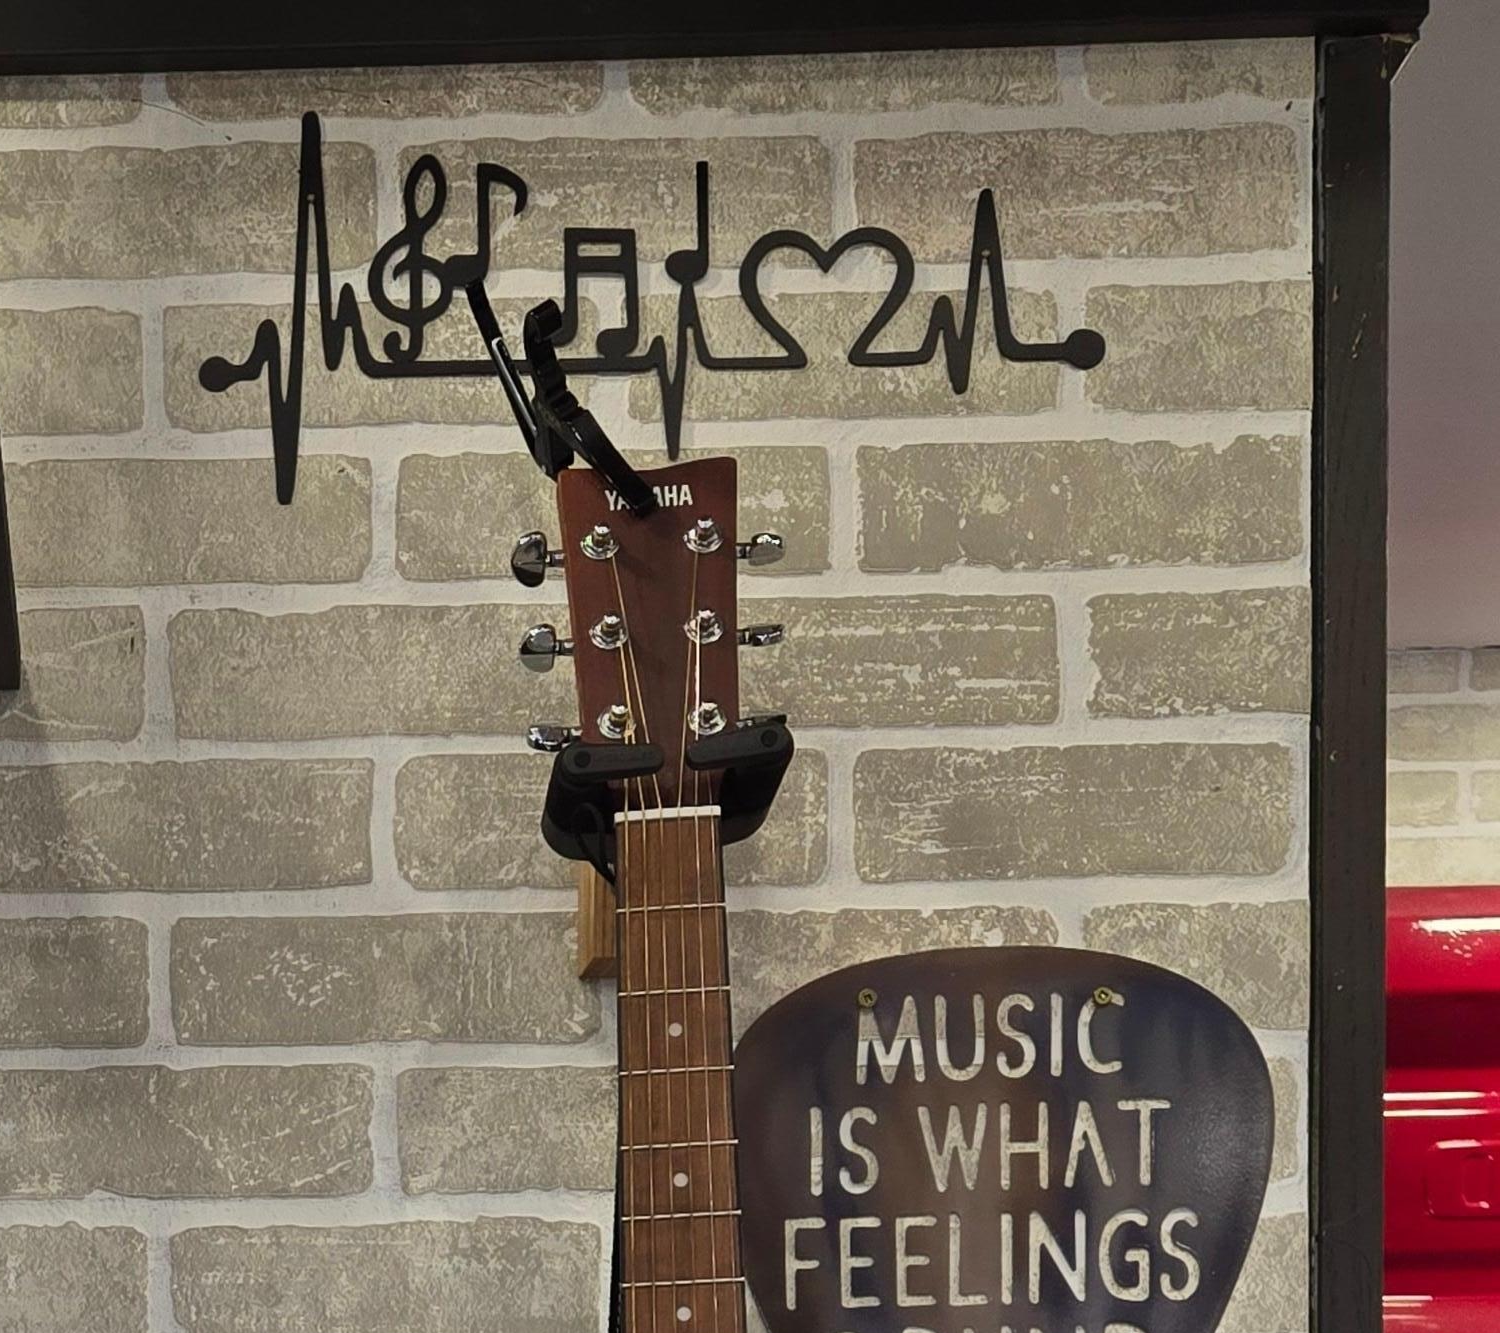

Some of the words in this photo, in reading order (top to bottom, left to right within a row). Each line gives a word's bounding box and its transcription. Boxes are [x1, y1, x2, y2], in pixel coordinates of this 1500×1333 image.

[604, 484, 693, 511] YAAHA
[856, 992, 1125, 1085] MUSIC
[809, 1105, 879, 1196] IS
[918, 1100, 1172, 1192] WHAT
[784, 1208, 1201, 1310] FEELINGS
